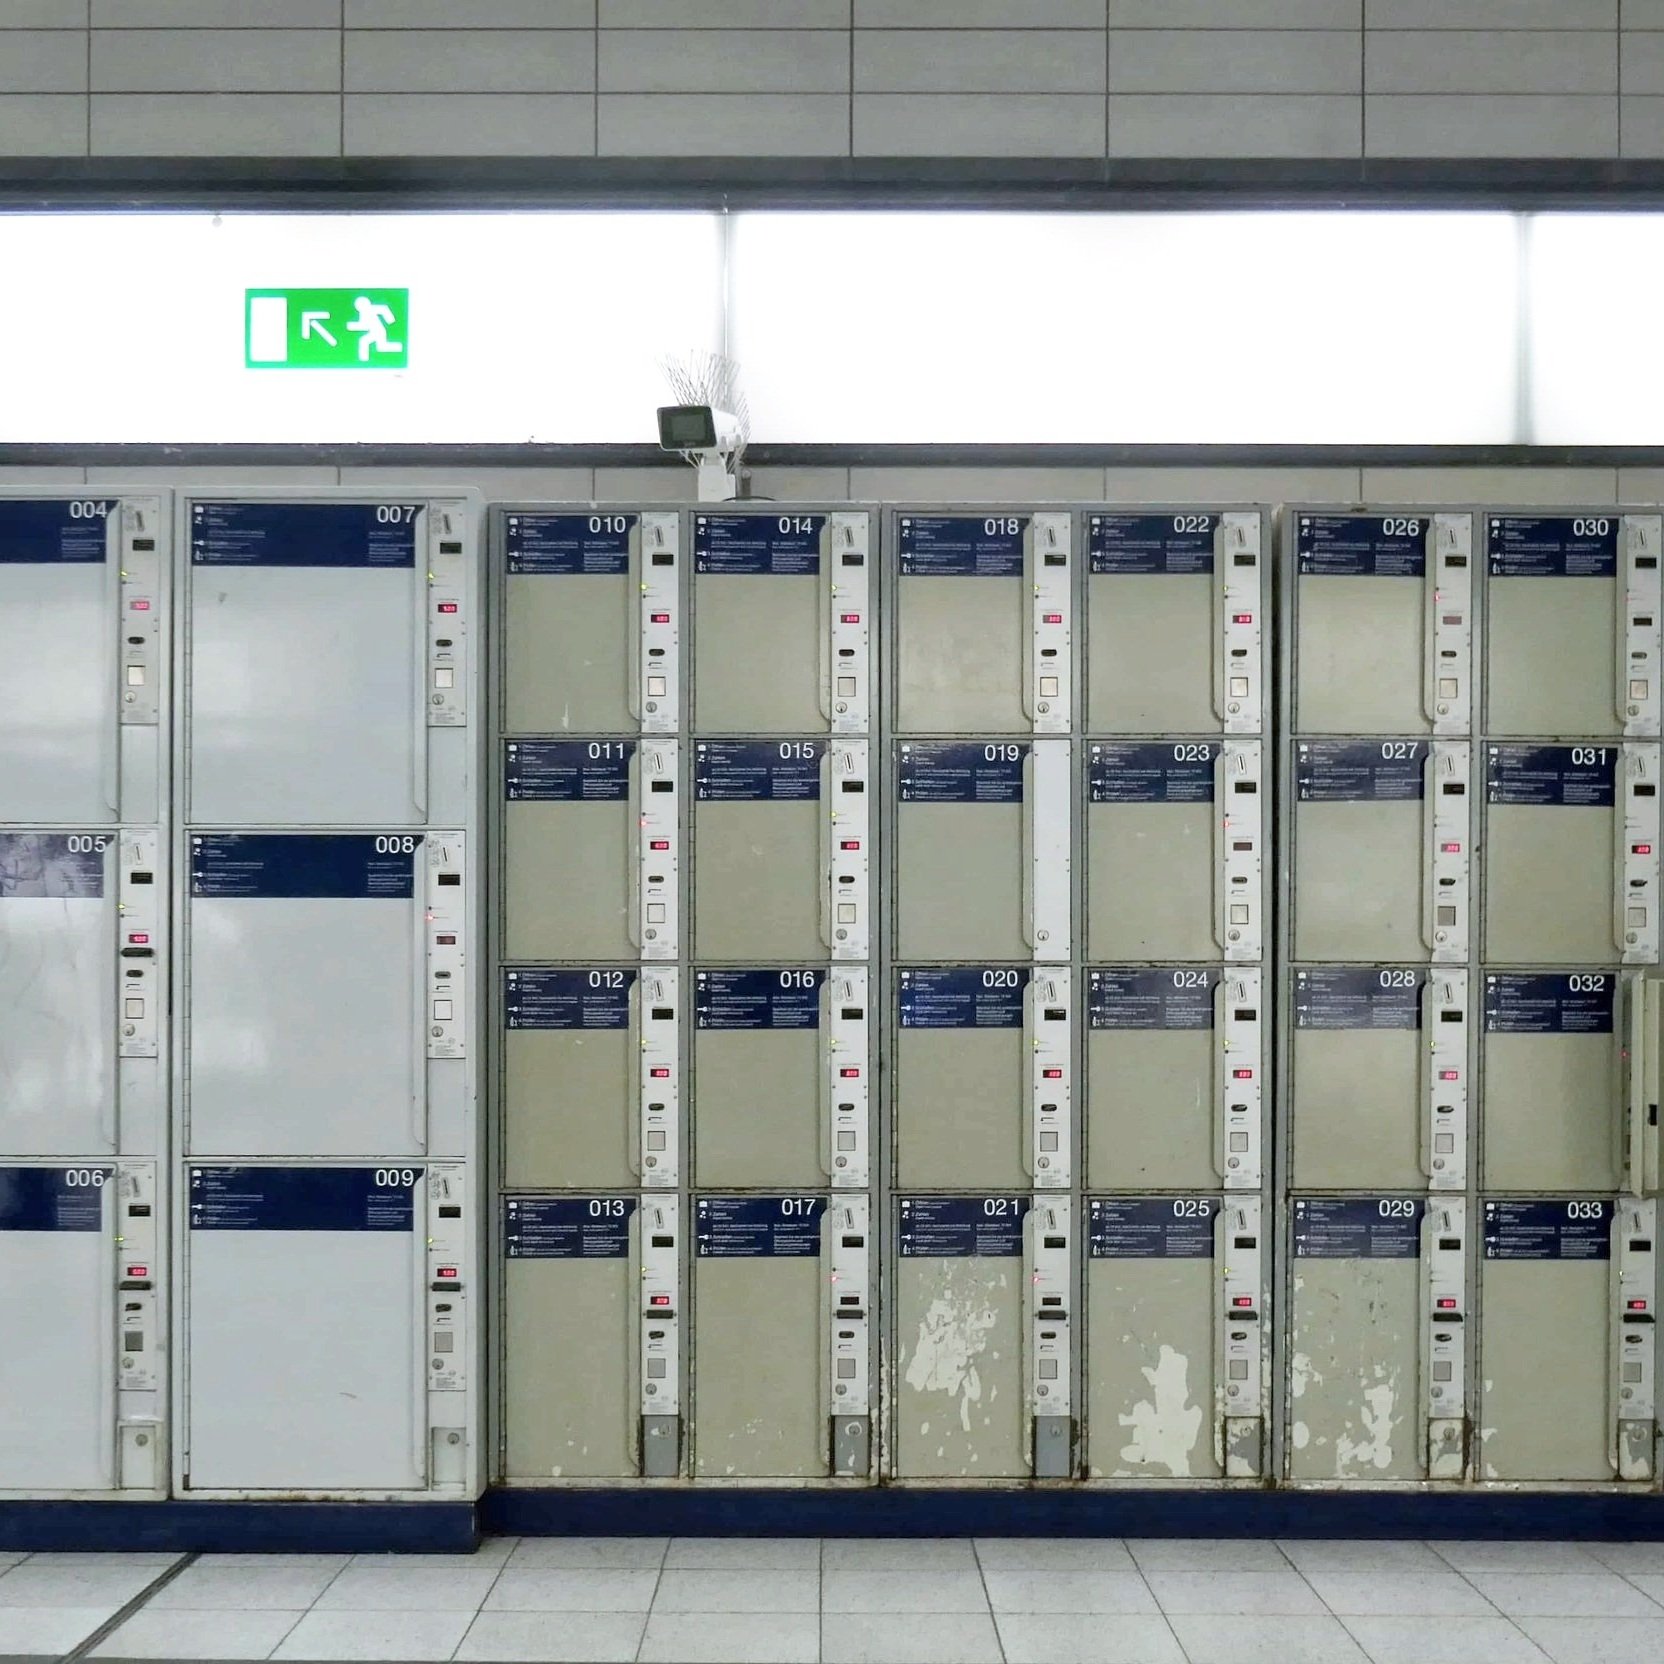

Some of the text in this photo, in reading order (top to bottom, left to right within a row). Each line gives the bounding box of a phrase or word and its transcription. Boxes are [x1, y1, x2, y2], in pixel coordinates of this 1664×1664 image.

[70, 501, 108, 519] 004
[377, 505, 415, 523] 007
[589, 516, 626, 533] 010
[778, 516, 813, 534] 014
[984, 518, 1019, 536] 018
[1173, 516, 1209, 533] 022
[1383, 518, 1419, 537] 026
[1573, 519, 1609, 536] 030
[588, 742, 624, 759] 011
[779, 742, 815, 759] 015
[984, 744, 1019, 762] 019
[1173, 744, 1210, 762] 023
[1381, 741, 1419, 760] 027
[1571, 747, 1606, 765] 031
[67, 835, 106, 853] 005
[375, 836, 414, 854] 008
[589, 970, 624, 988] 012
[780, 970, 815, 988] 016
[982, 970, 1018, 987] 020
[1173, 970, 1209, 988] 024
[1379, 969, 1416, 988] 028
[1569, 974, 1605, 992] 032
[65, 1169, 105, 1187] 006
[375, 1169, 414, 1187] 009
[589, 1199, 625, 1217] 013
[781, 1198, 816, 1216] 017
[983, 1198, 1018, 1216] 021
[1173, 1199, 1210, 1217] 025
[1378, 1199, 1415, 1218] 029
[1567, 1201, 1603, 1219] 033
